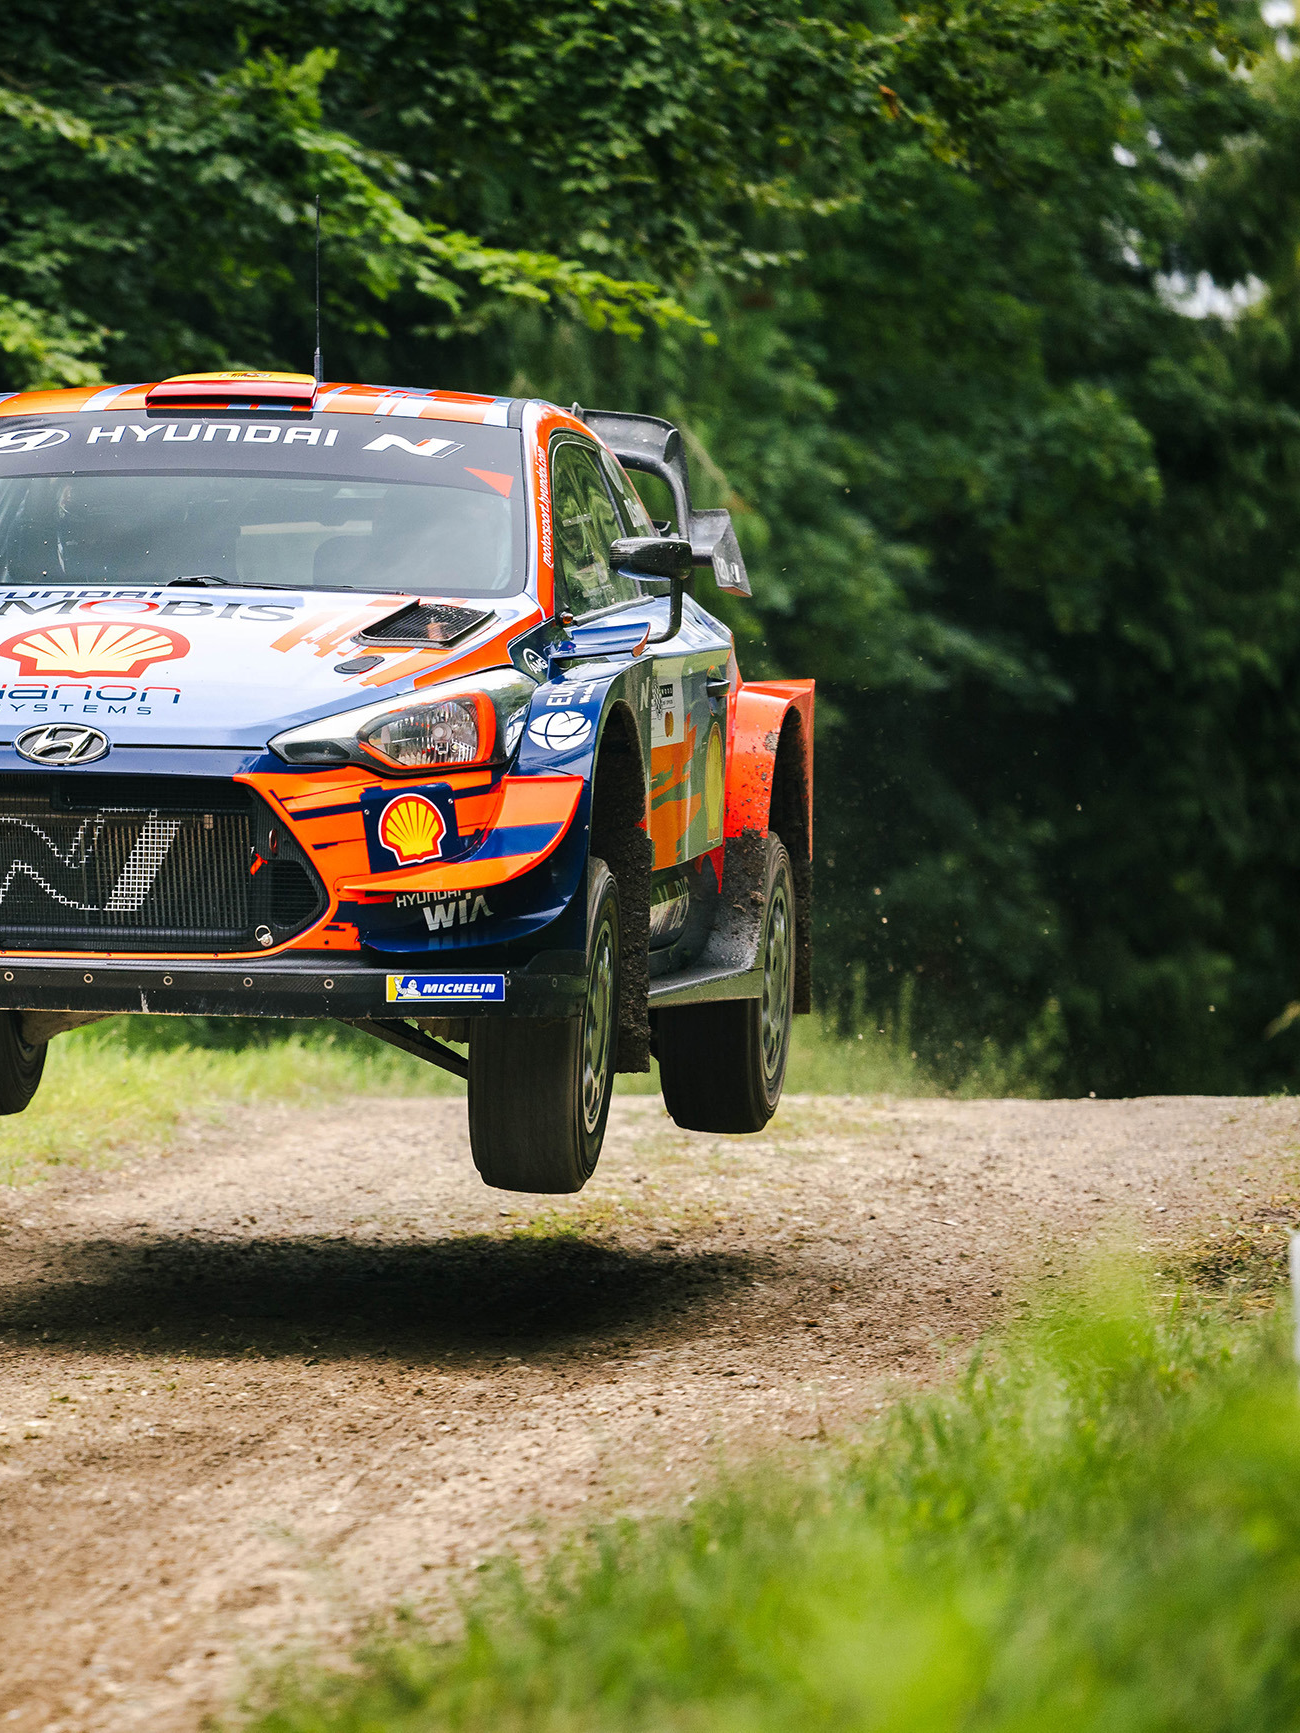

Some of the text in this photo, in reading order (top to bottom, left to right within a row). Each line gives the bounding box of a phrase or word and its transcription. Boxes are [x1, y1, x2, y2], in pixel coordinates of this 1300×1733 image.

[86, 424, 339, 447] HYUNDAI
[534, 445, 552, 569] motorsport.hyundai.com
[422, 892, 495, 932] WIA
[422, 983, 496, 994] MICHELIN
